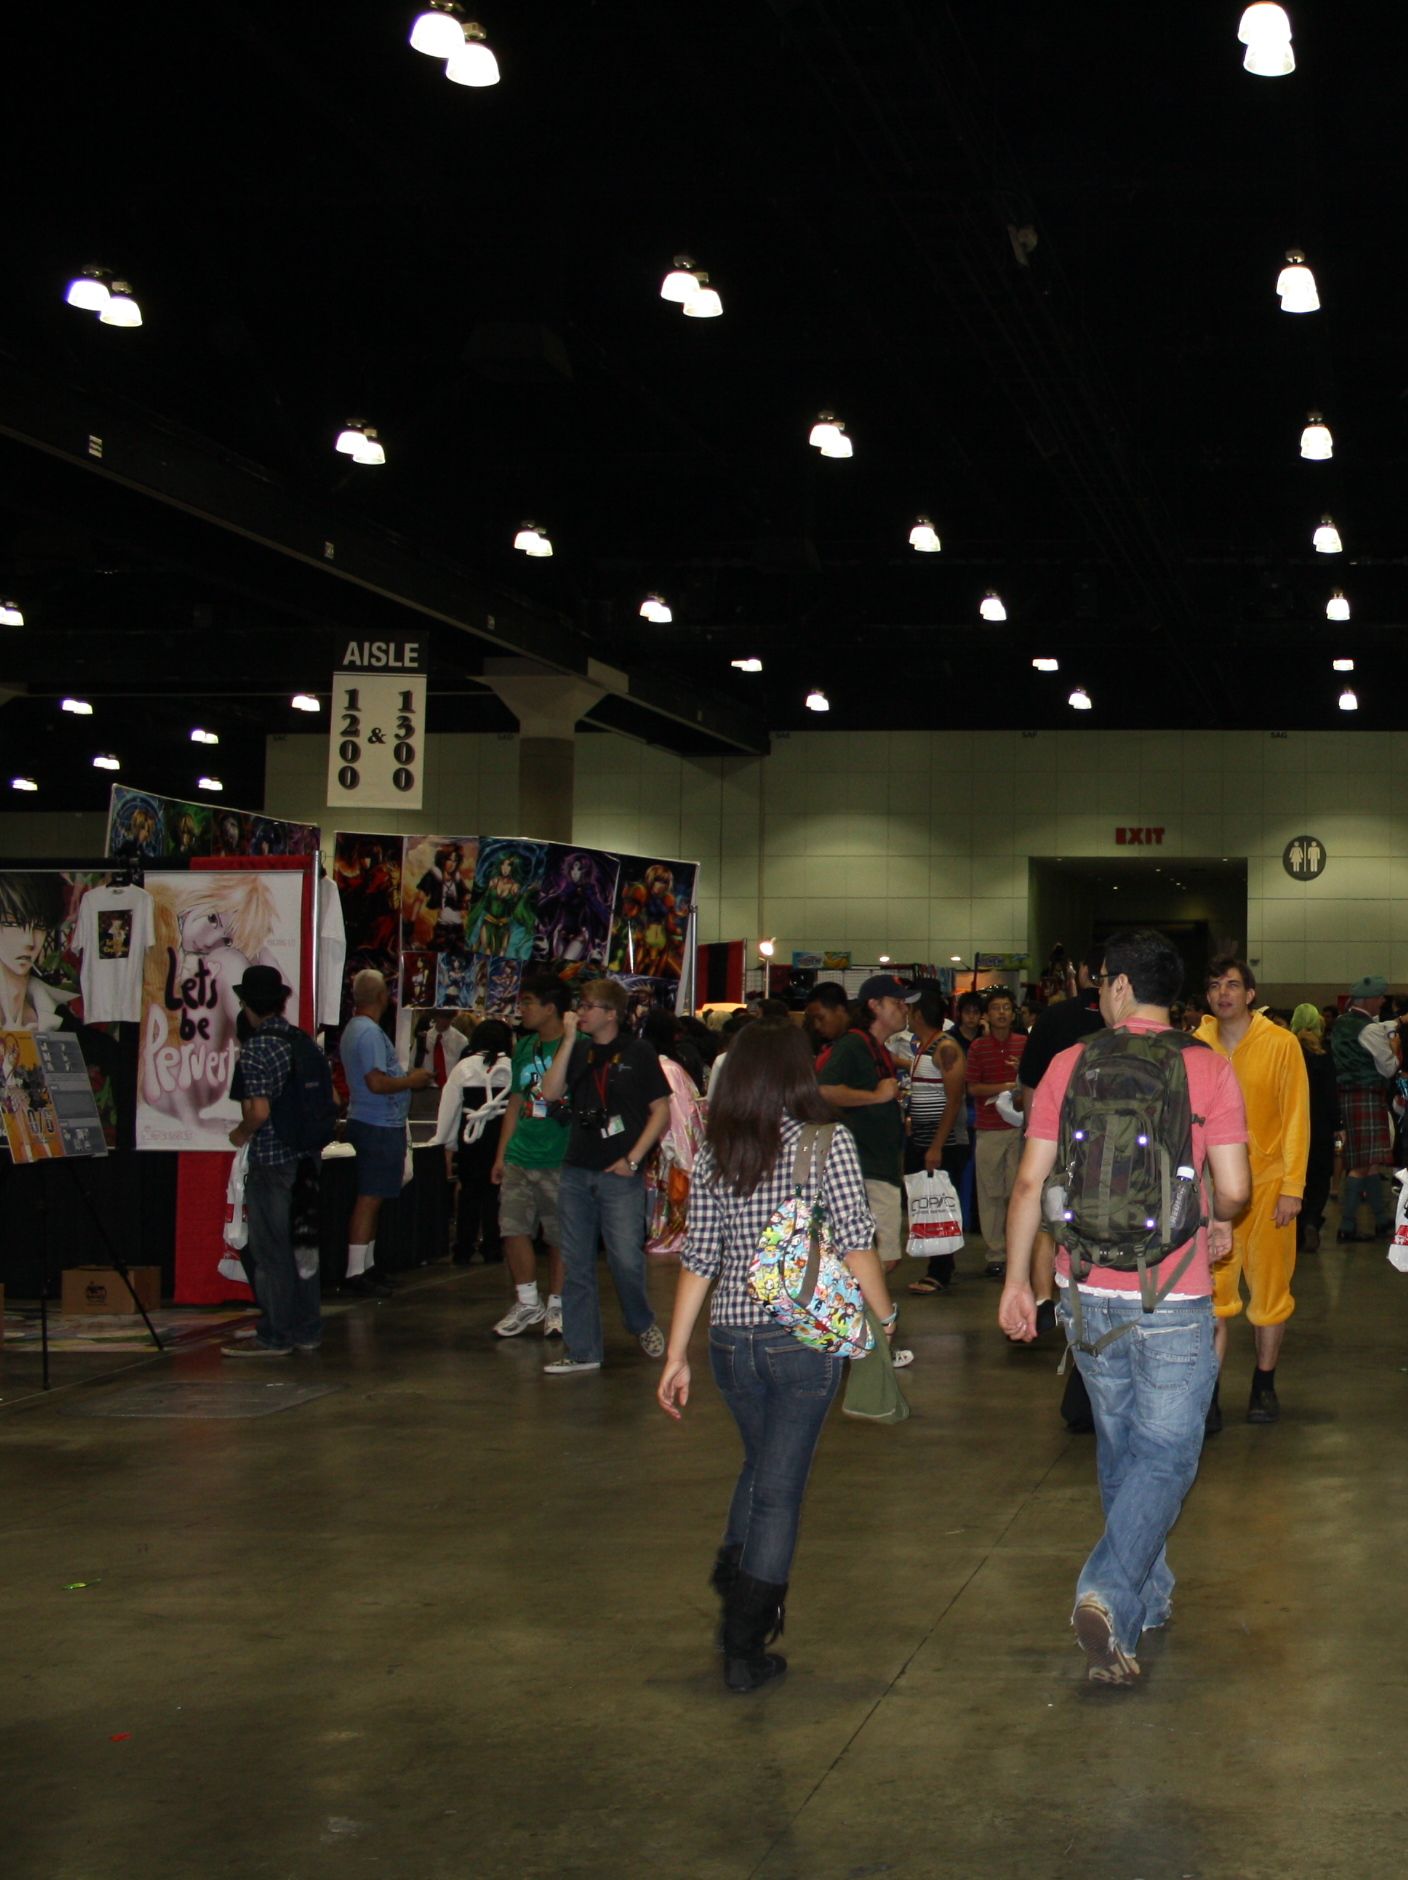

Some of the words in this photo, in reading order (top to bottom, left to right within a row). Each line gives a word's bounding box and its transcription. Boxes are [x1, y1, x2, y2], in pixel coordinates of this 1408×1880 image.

[342, 641, 420, 668] AISLE
[1115, 827, 1165, 845] EXIT
[180, 1006, 210, 1041] be
